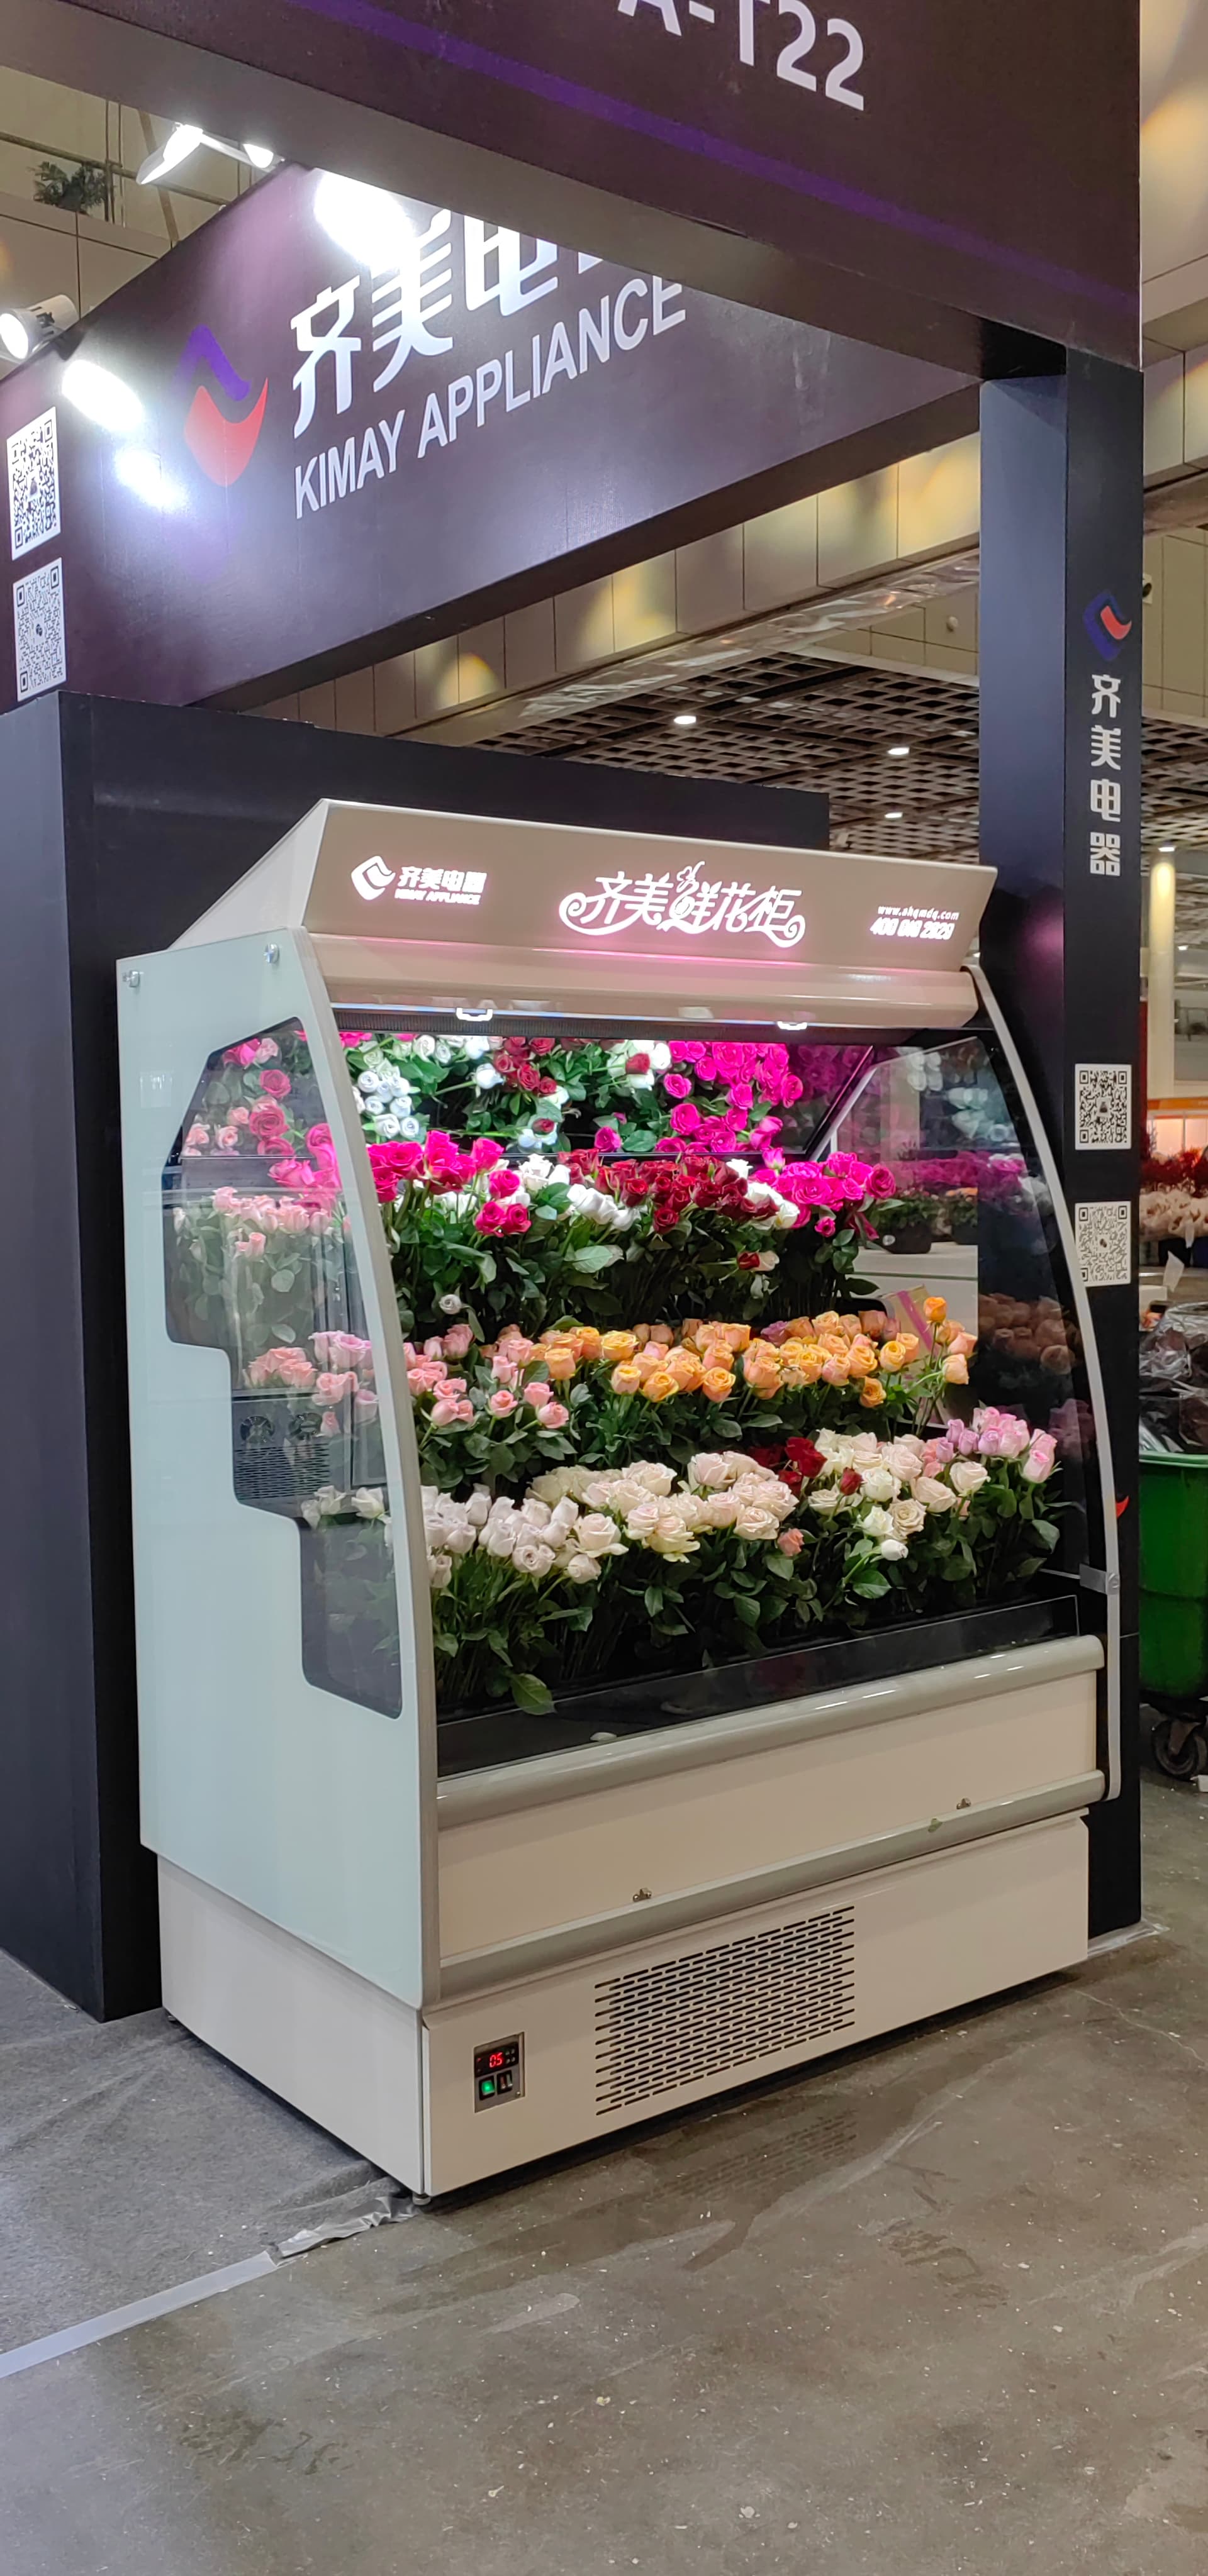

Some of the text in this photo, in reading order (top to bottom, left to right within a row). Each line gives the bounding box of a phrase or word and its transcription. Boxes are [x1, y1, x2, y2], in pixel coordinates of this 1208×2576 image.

[290, 209, 602, 438] 齐美电
[294, 275, 686, 519] KIMAY APPLIANCE
[1090, 674, 1121, 877] 齐美电器
[559, 861, 805, 948] 齐美鲜花柜
[870, 917, 899, 936] 400
